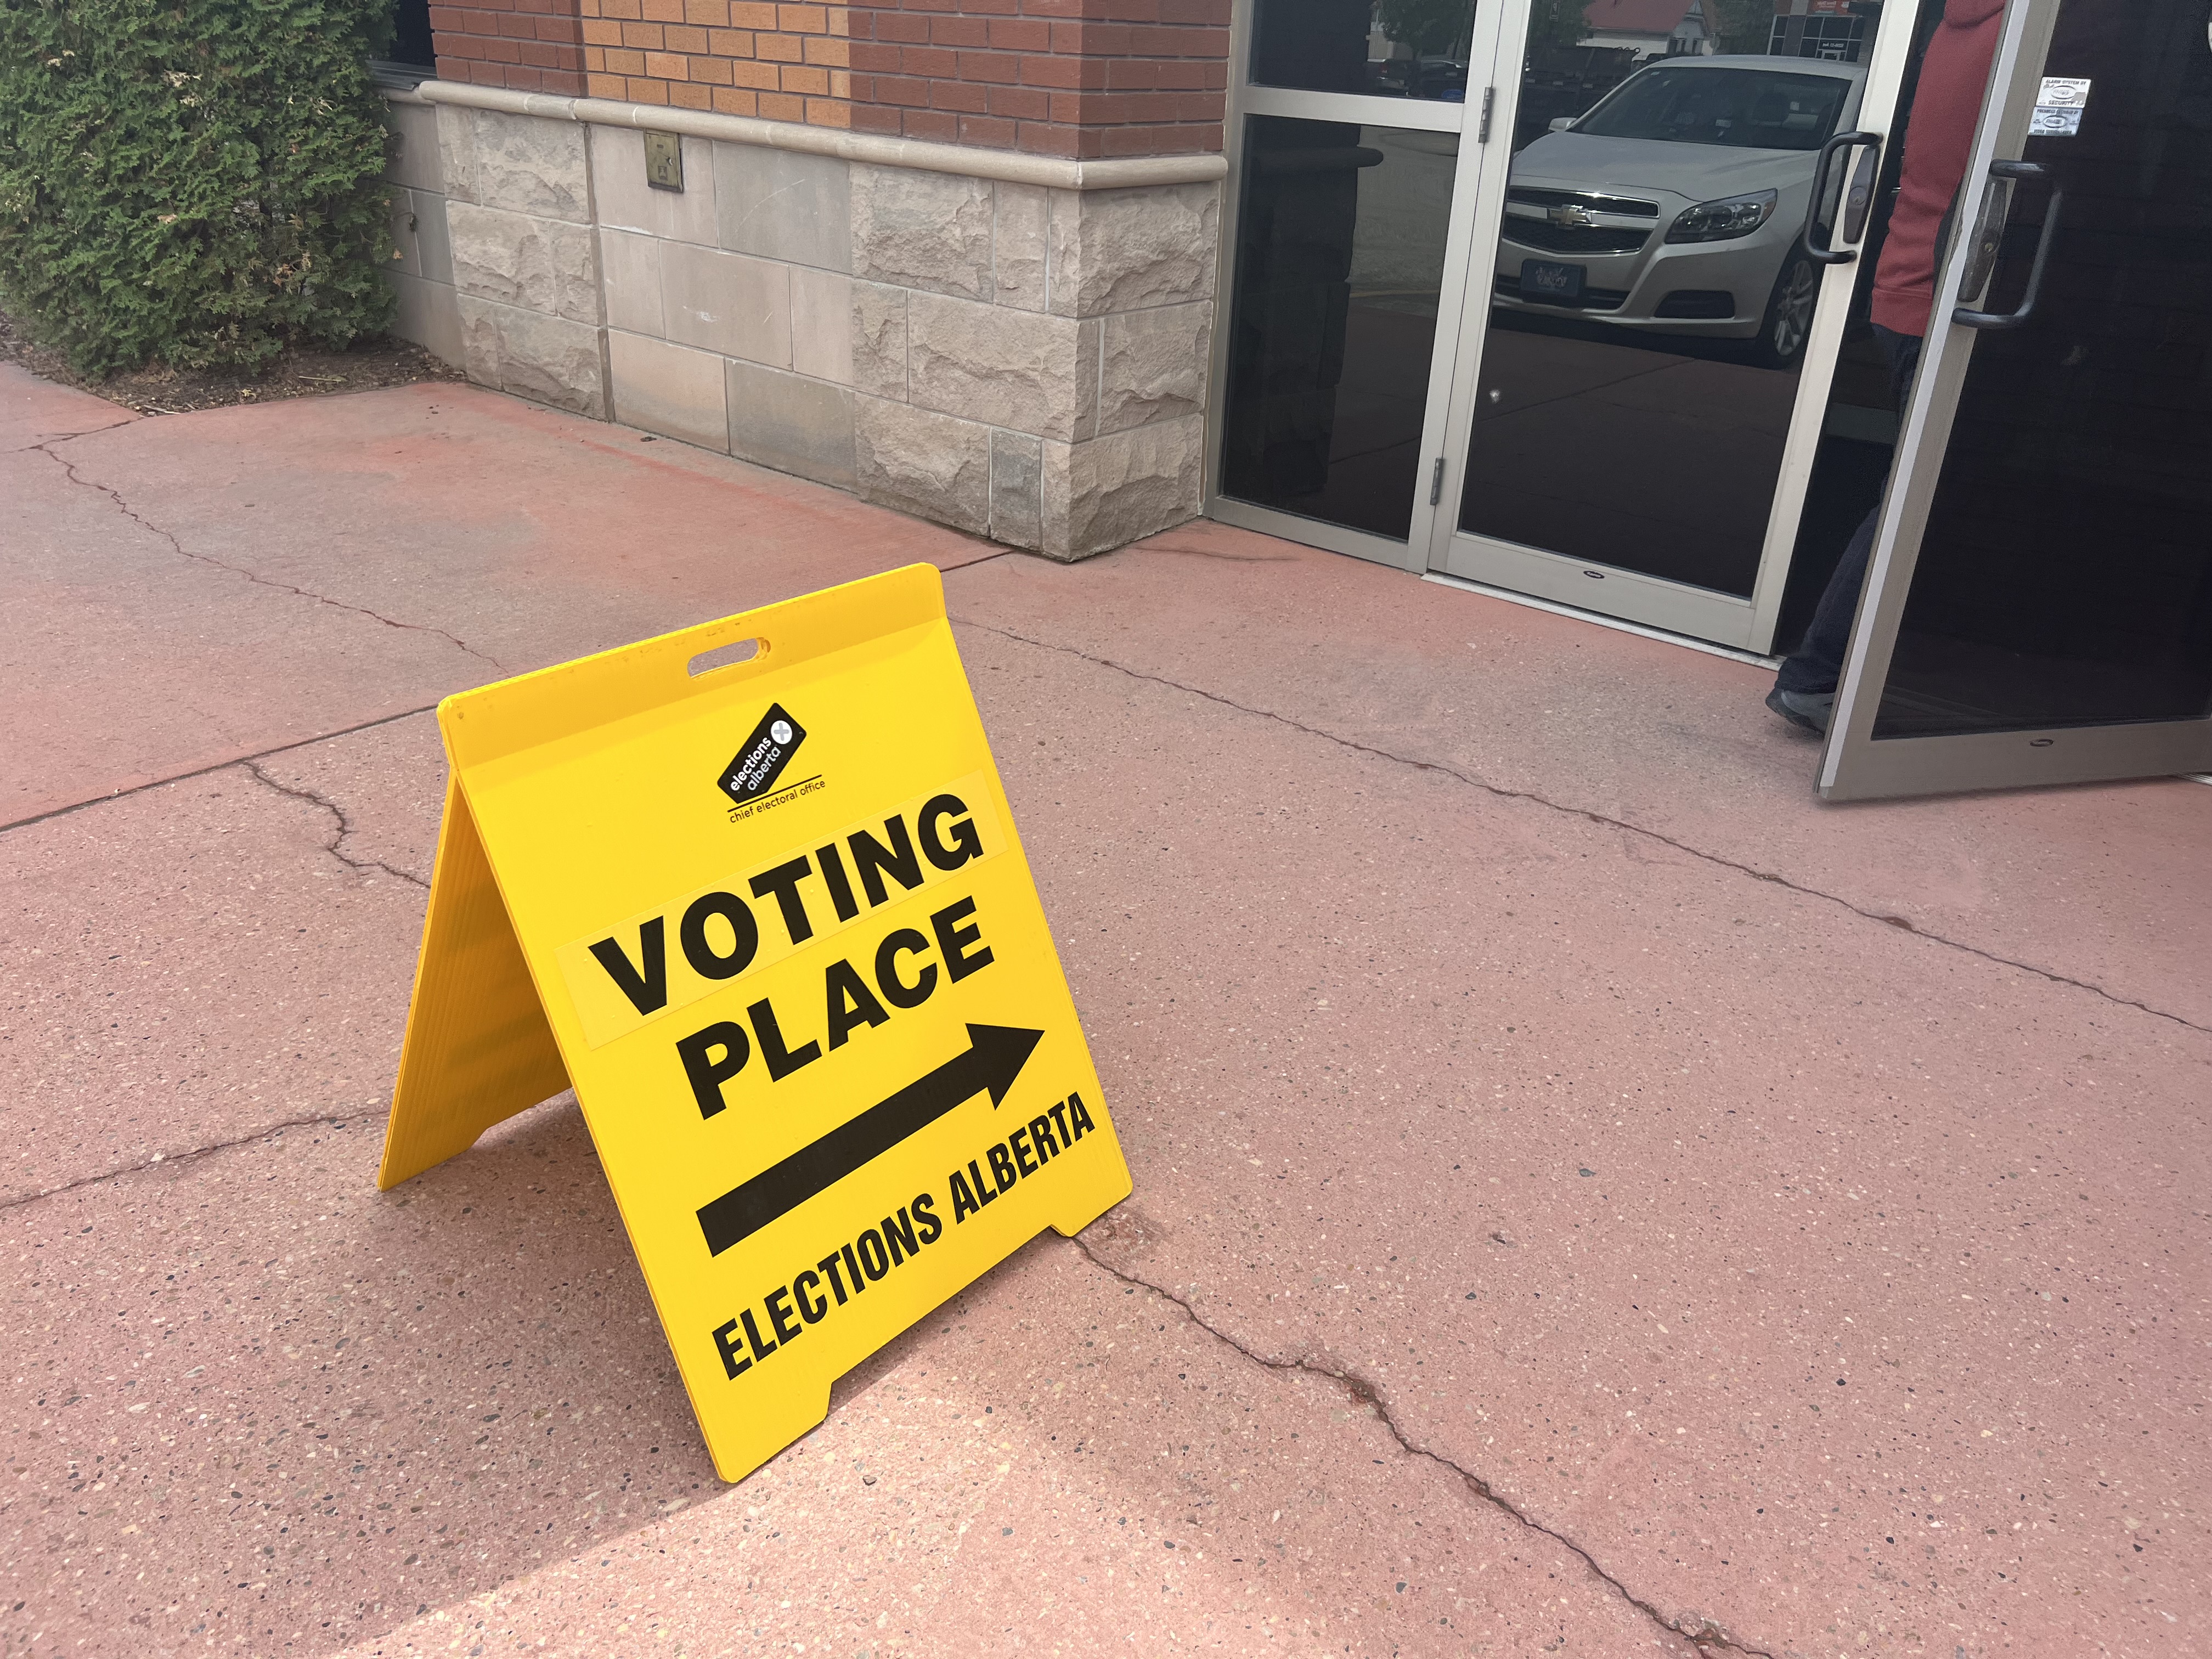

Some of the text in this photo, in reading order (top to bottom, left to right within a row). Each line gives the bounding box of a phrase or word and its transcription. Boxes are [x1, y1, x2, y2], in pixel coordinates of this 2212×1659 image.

[730, 737, 771, 791] elections
[730, 781, 826, 823] chief electoral office
[747, 746, 781, 791] alberta
[588, 794, 984, 1016] VOTING
[676, 895, 995, 1120] PLACE
[712, 1092, 1095, 1380] ELECTIONS ALBERTA
